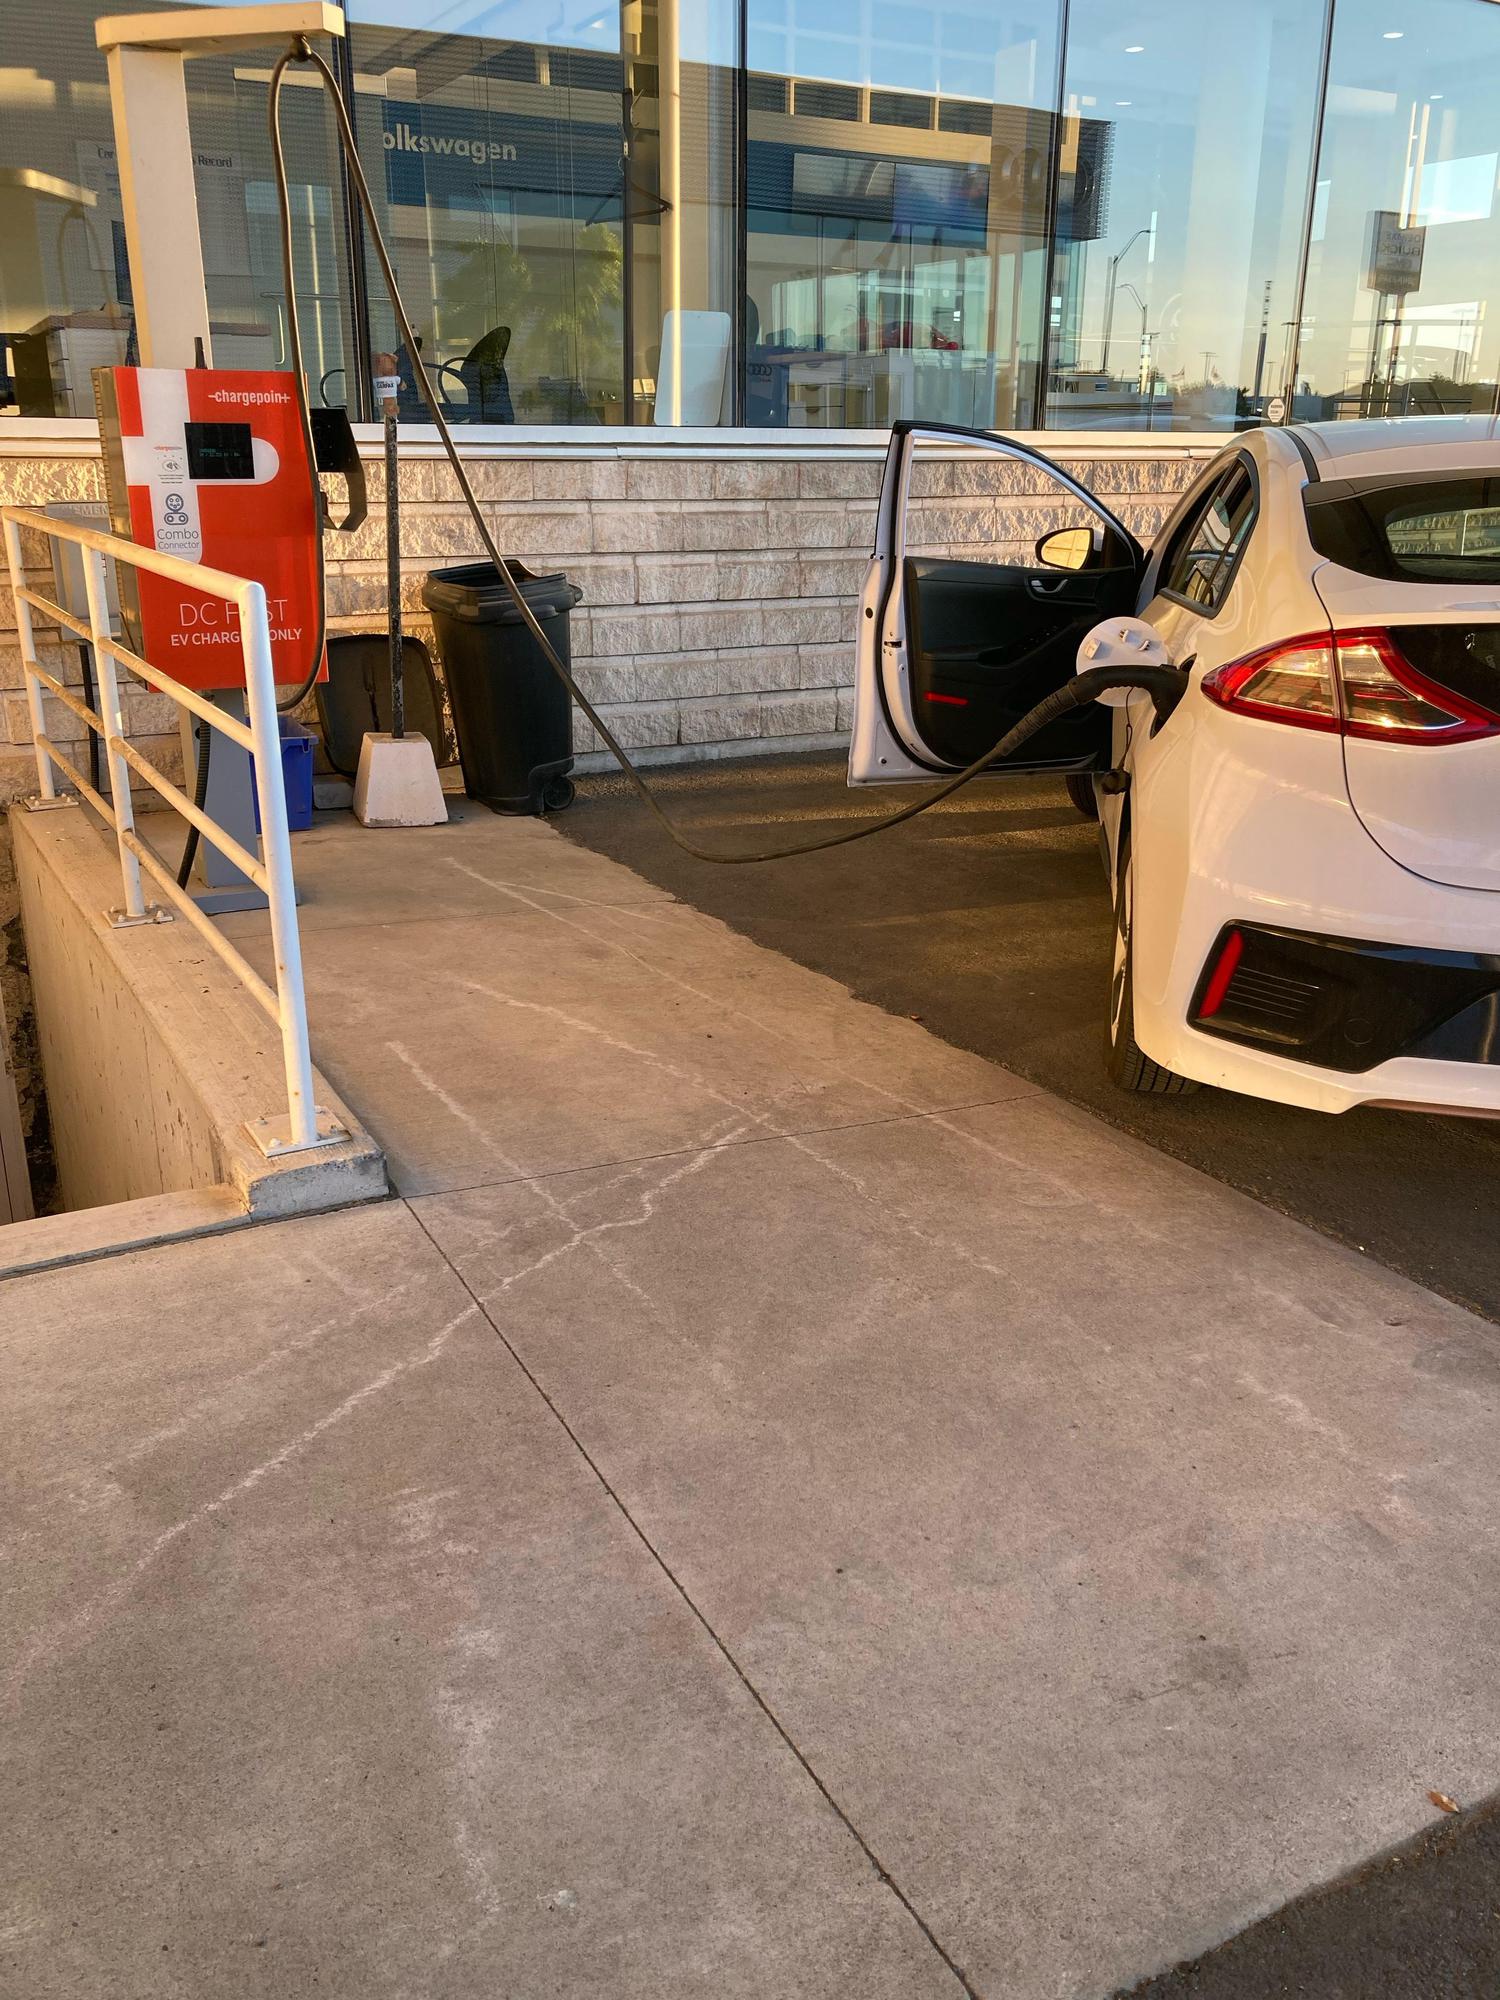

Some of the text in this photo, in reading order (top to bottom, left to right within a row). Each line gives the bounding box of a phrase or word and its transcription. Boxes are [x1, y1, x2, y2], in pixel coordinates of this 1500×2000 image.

[382, 123, 517, 165] olkswagen
[197, 154, 233, 168] Record
[157, 528, 199, 540] Combo
[158, 541, 200, 549] Connector
[179, 599, 288, 626] DC FST
[170, 627, 302, 646] EV CHARG ONLY
